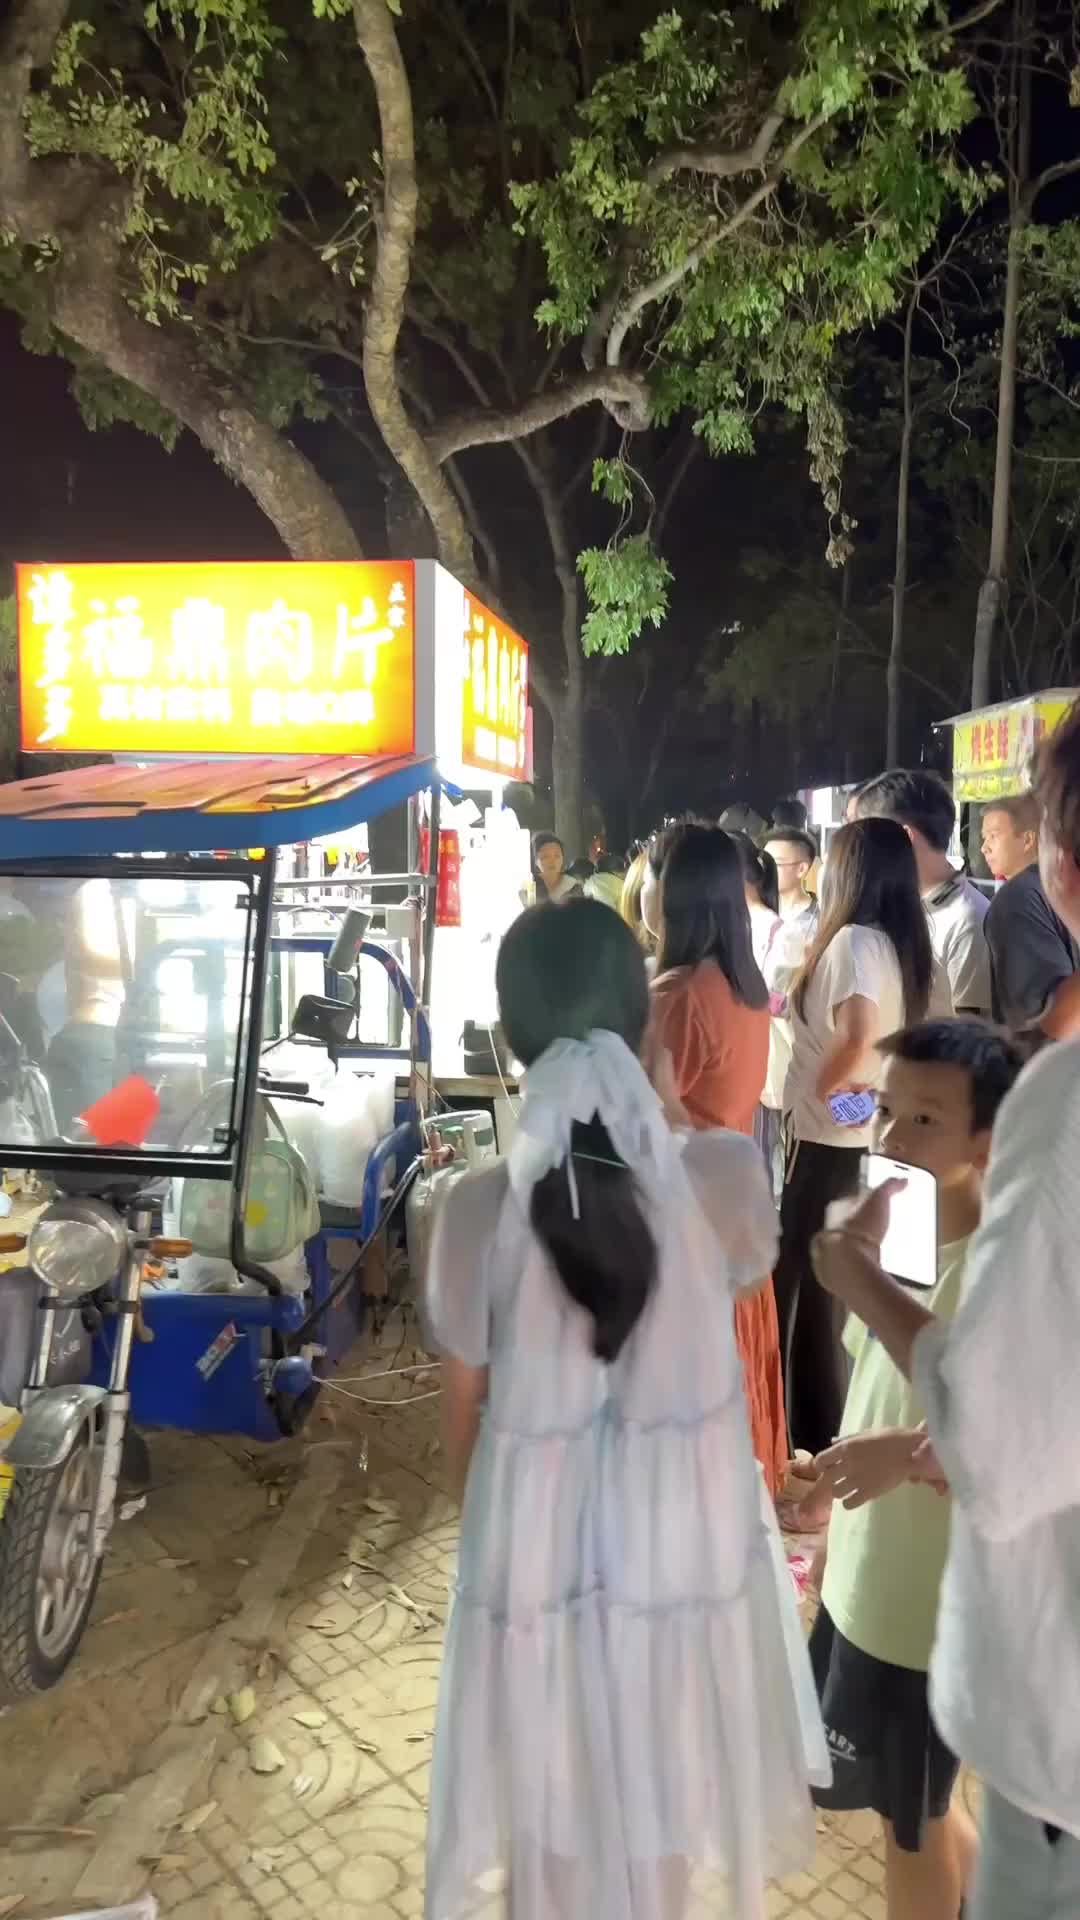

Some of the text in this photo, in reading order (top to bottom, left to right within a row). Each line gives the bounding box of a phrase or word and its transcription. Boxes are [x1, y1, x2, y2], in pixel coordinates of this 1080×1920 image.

[82, 595, 394, 685] 福鼎肉片
[824, 1724, 856, 1752] ART
